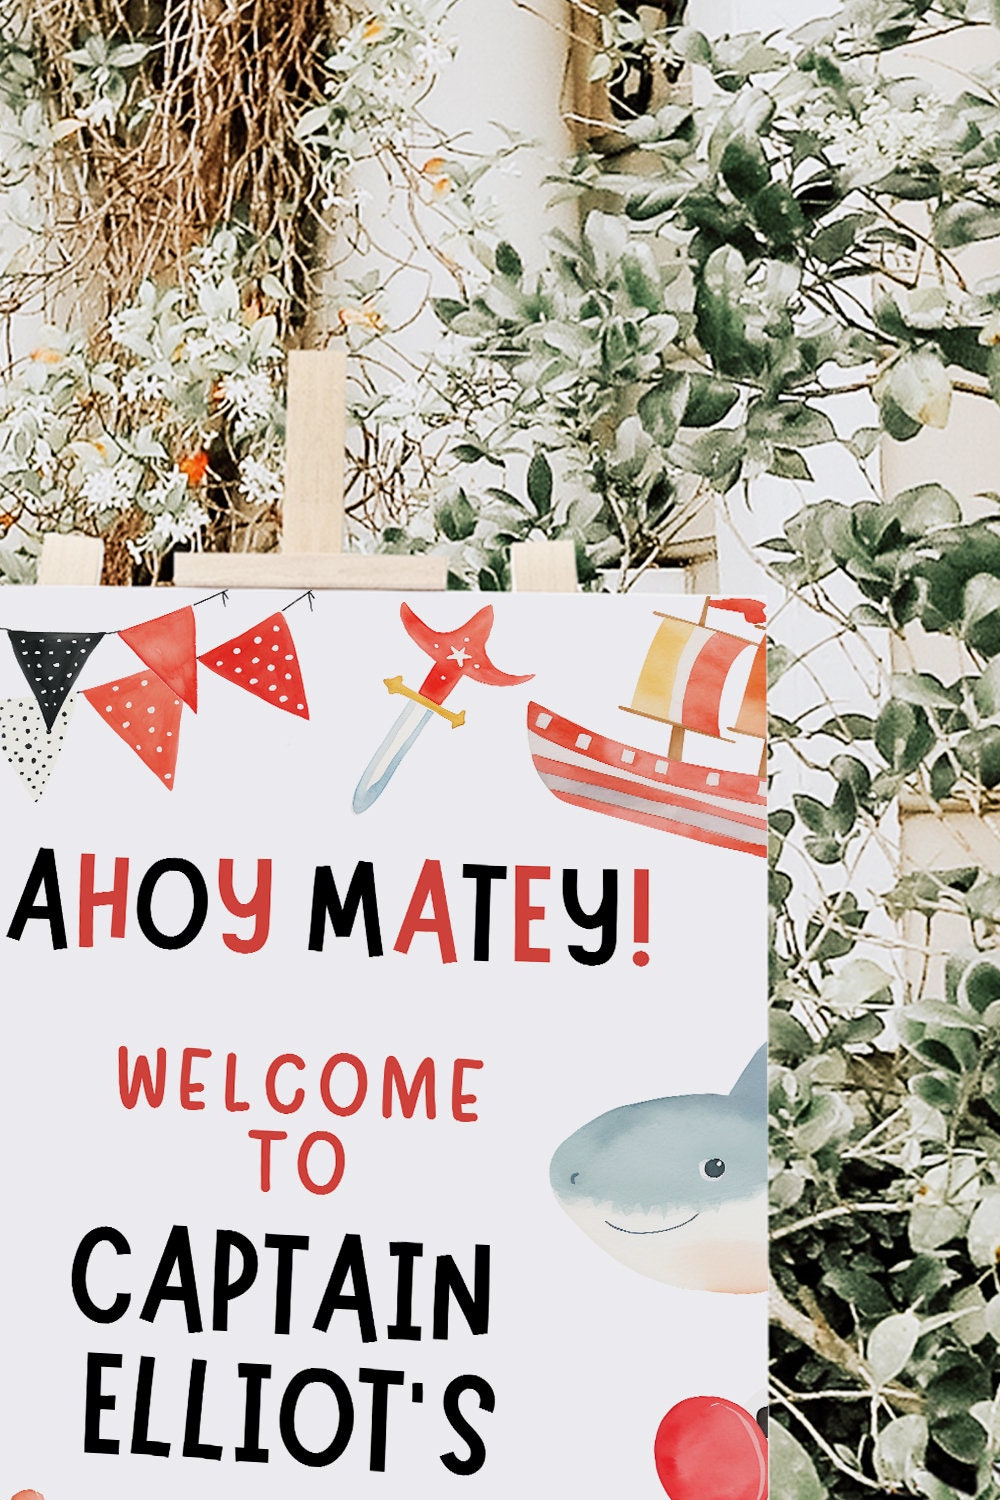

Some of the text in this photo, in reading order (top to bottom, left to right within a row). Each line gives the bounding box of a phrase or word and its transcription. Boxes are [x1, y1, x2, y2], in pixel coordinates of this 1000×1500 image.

[6, 847, 651, 968] AHOY MATEY!
[117, 1045, 485, 1123] WELCOME
[247, 1129, 346, 1196] TO
[71, 1225, 491, 1344] CAPTAIN
[83, 1351, 496, 1477] ELLIOT'S
